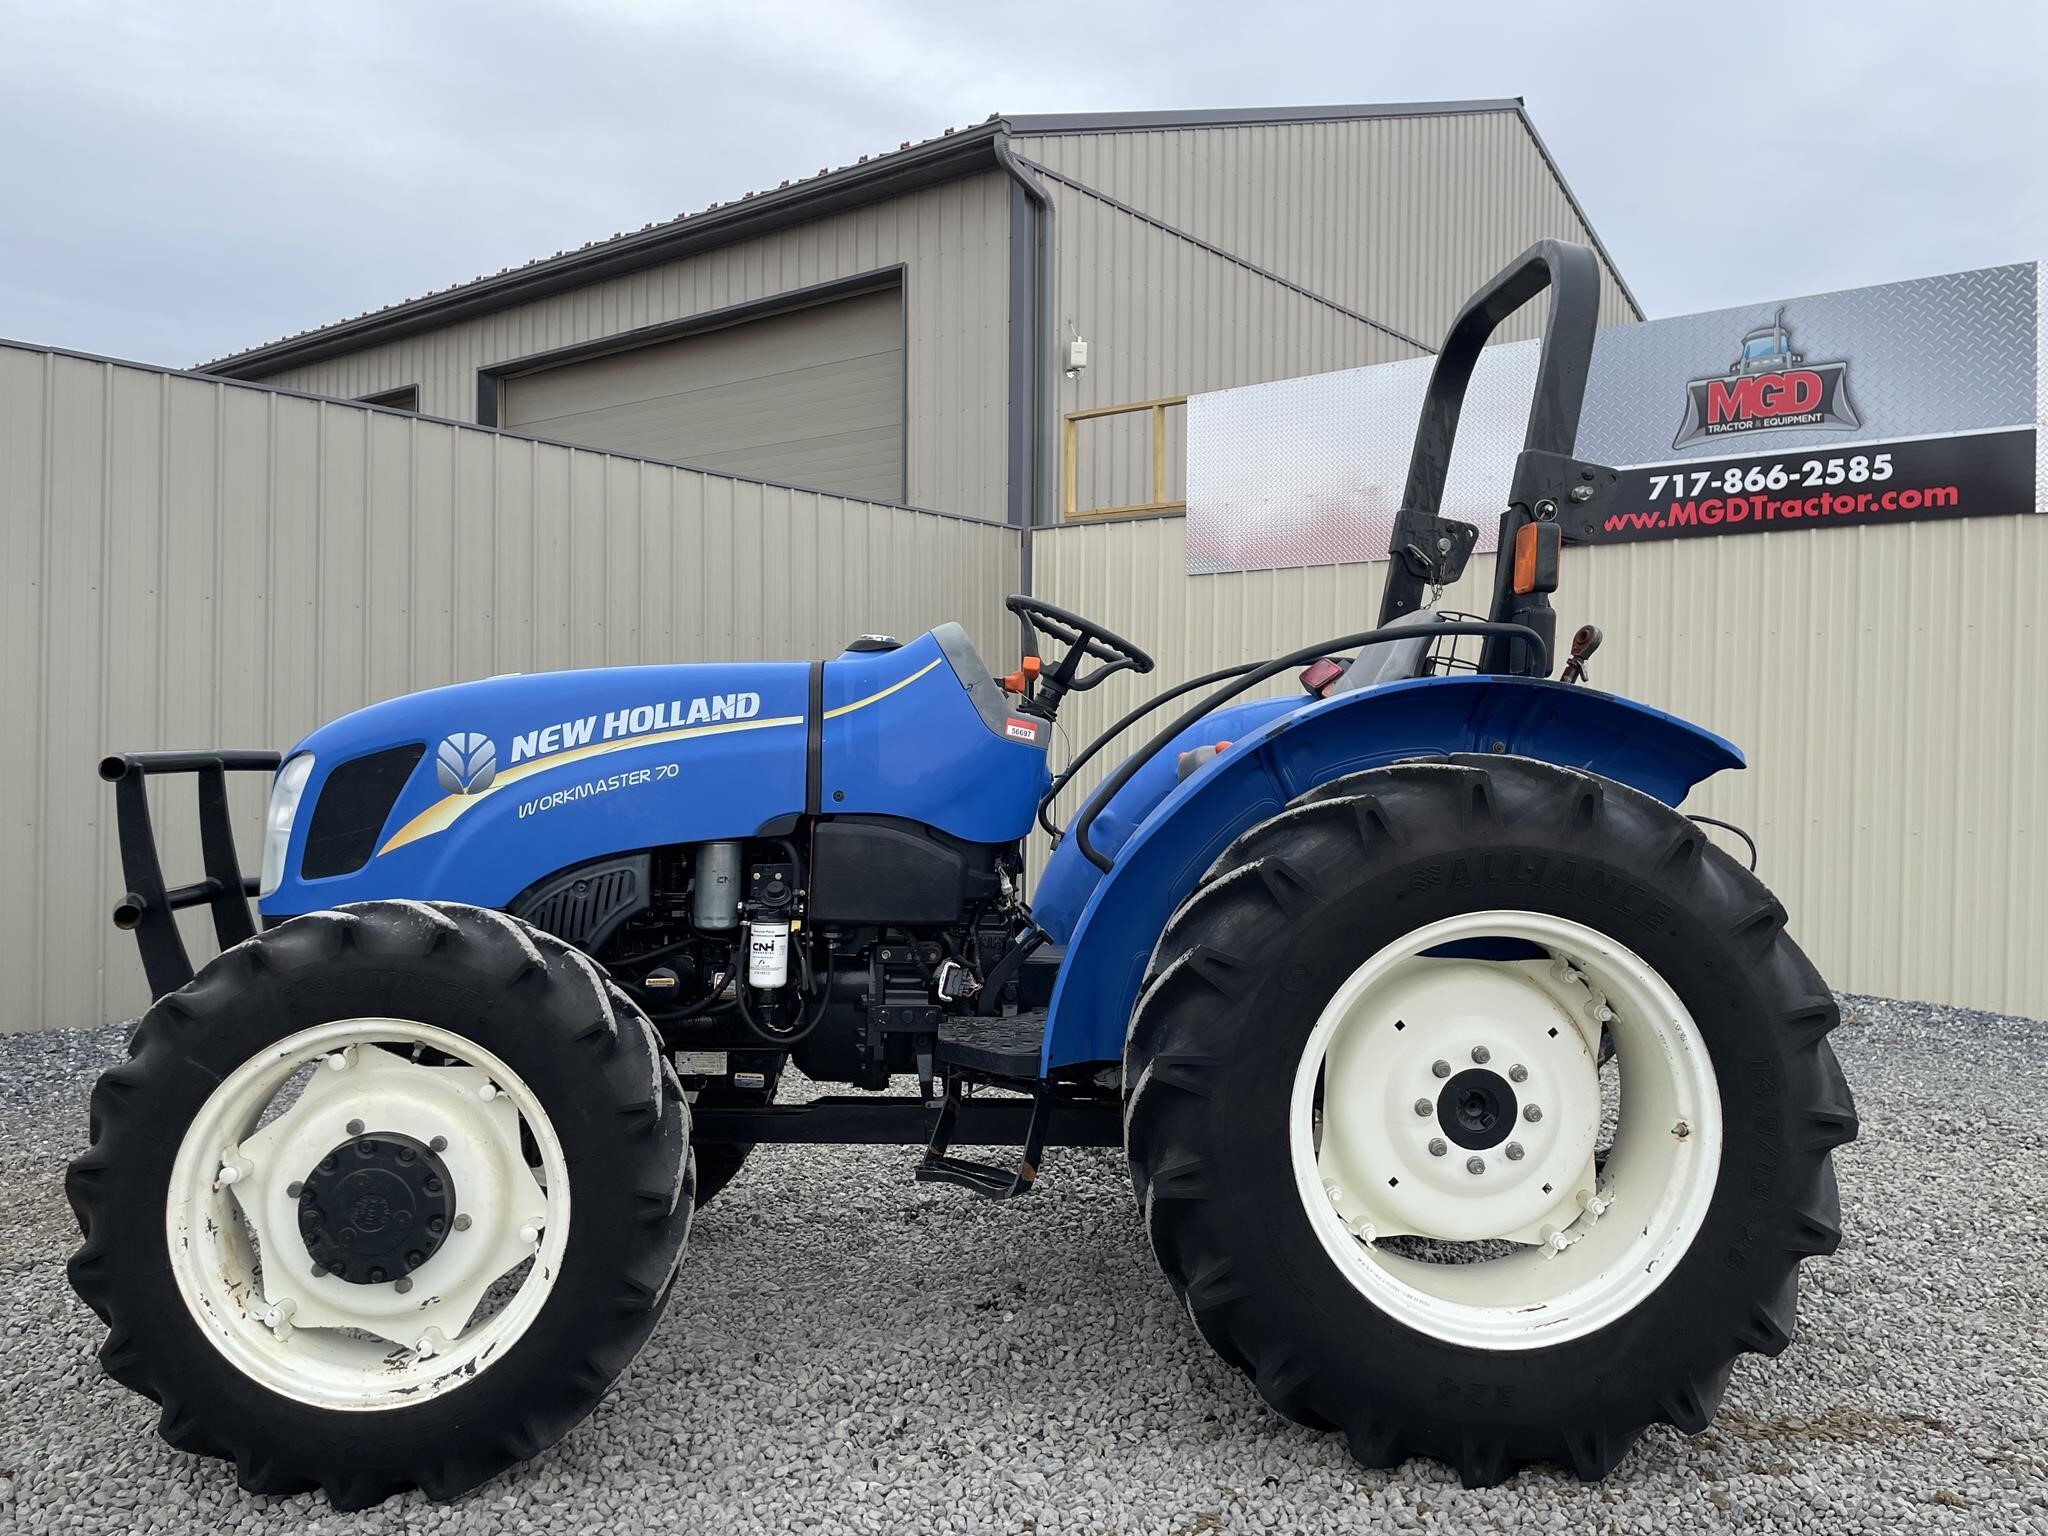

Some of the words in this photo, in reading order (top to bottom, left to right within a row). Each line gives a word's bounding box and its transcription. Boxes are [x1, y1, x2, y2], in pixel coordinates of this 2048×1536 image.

[1707, 370, 1823, 425] MGD
[1708, 420, 1754, 434] TRACTOR
[1763, 412, 1823, 428] EQUIPMENT
[1648, 454, 1893, 501] 717-866-2585
[1603, 485, 1958, 532] ww.MGDTractor.com
[510, 715, 597, 763] NEW
[602, 692, 760, 740] HOLLAND
[1011, 727, 1032, 738] 56697
[518, 768, 651, 819] WORKMASTER
[655, 764, 680, 782] 70
[1448, 852, 1673, 934] ALLIANCE
